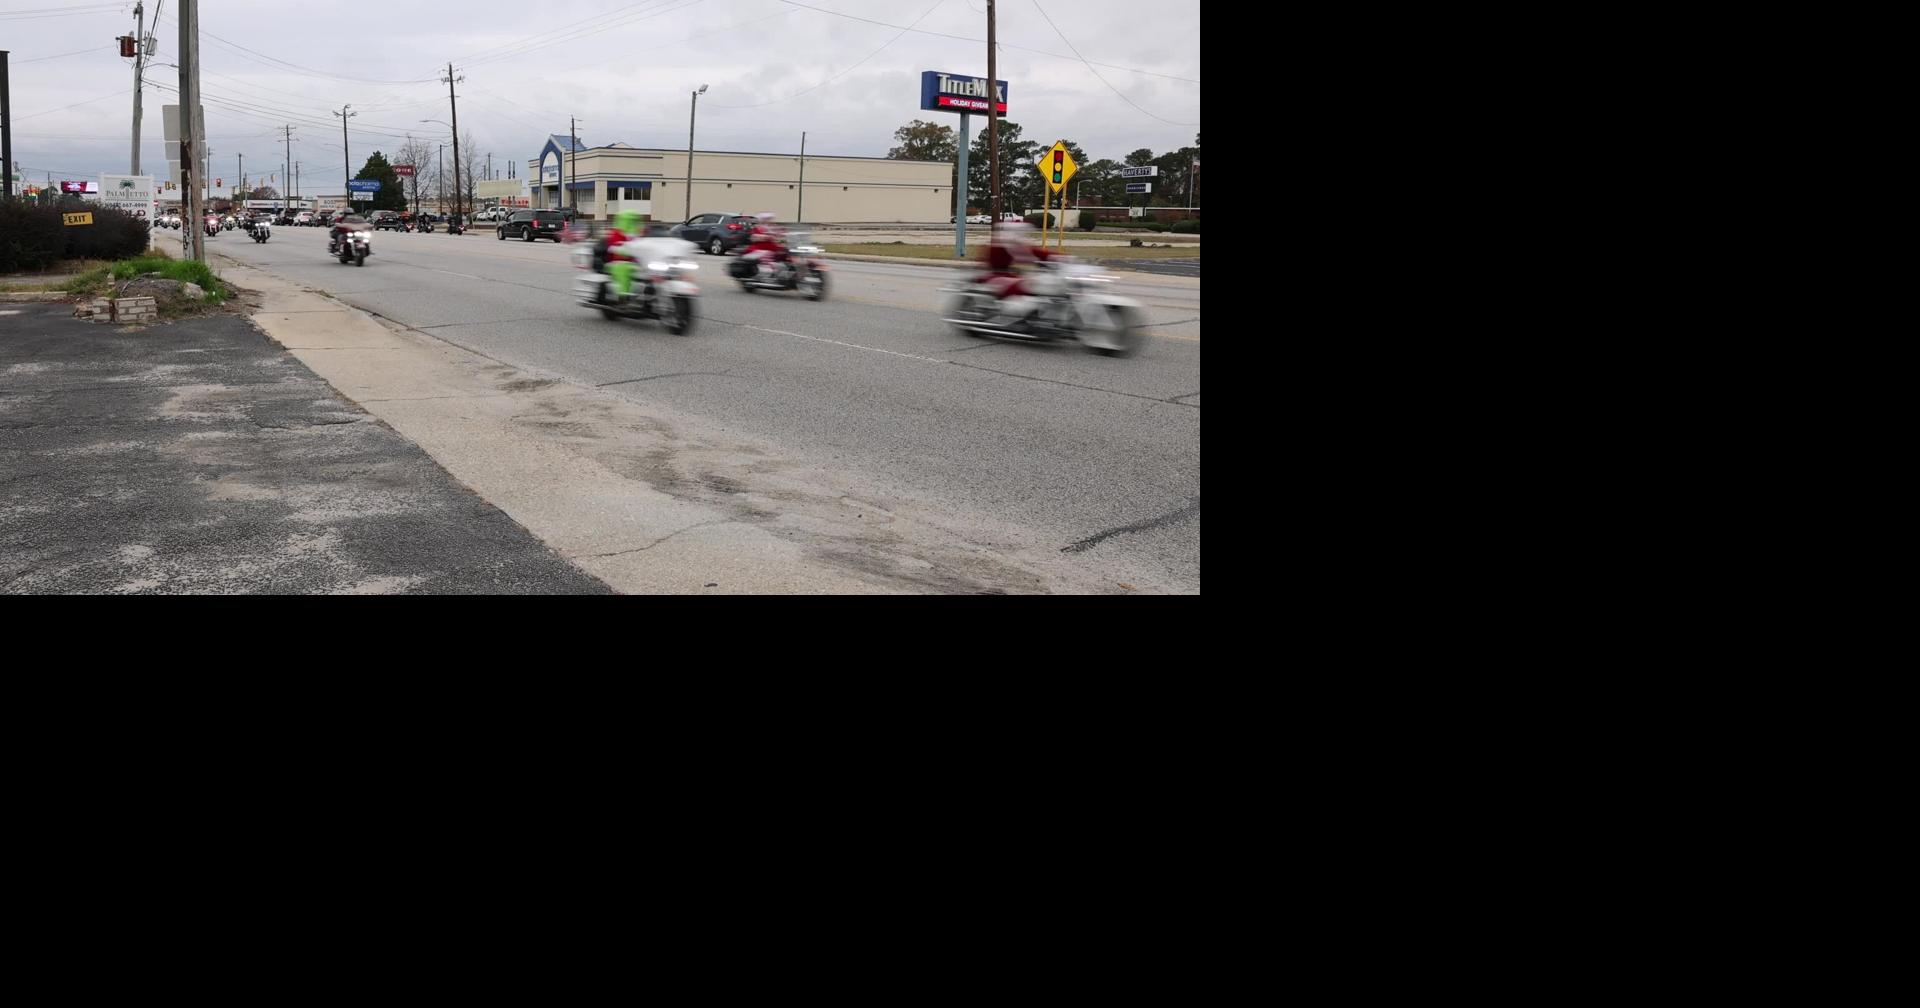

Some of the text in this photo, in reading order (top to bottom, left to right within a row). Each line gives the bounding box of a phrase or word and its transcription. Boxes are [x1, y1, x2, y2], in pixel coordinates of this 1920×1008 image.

[937, 74, 1004, 102] TITLEMX
[949, 99, 970, 107] HOLIDAY
[68, 215, 86, 223] EXIT
